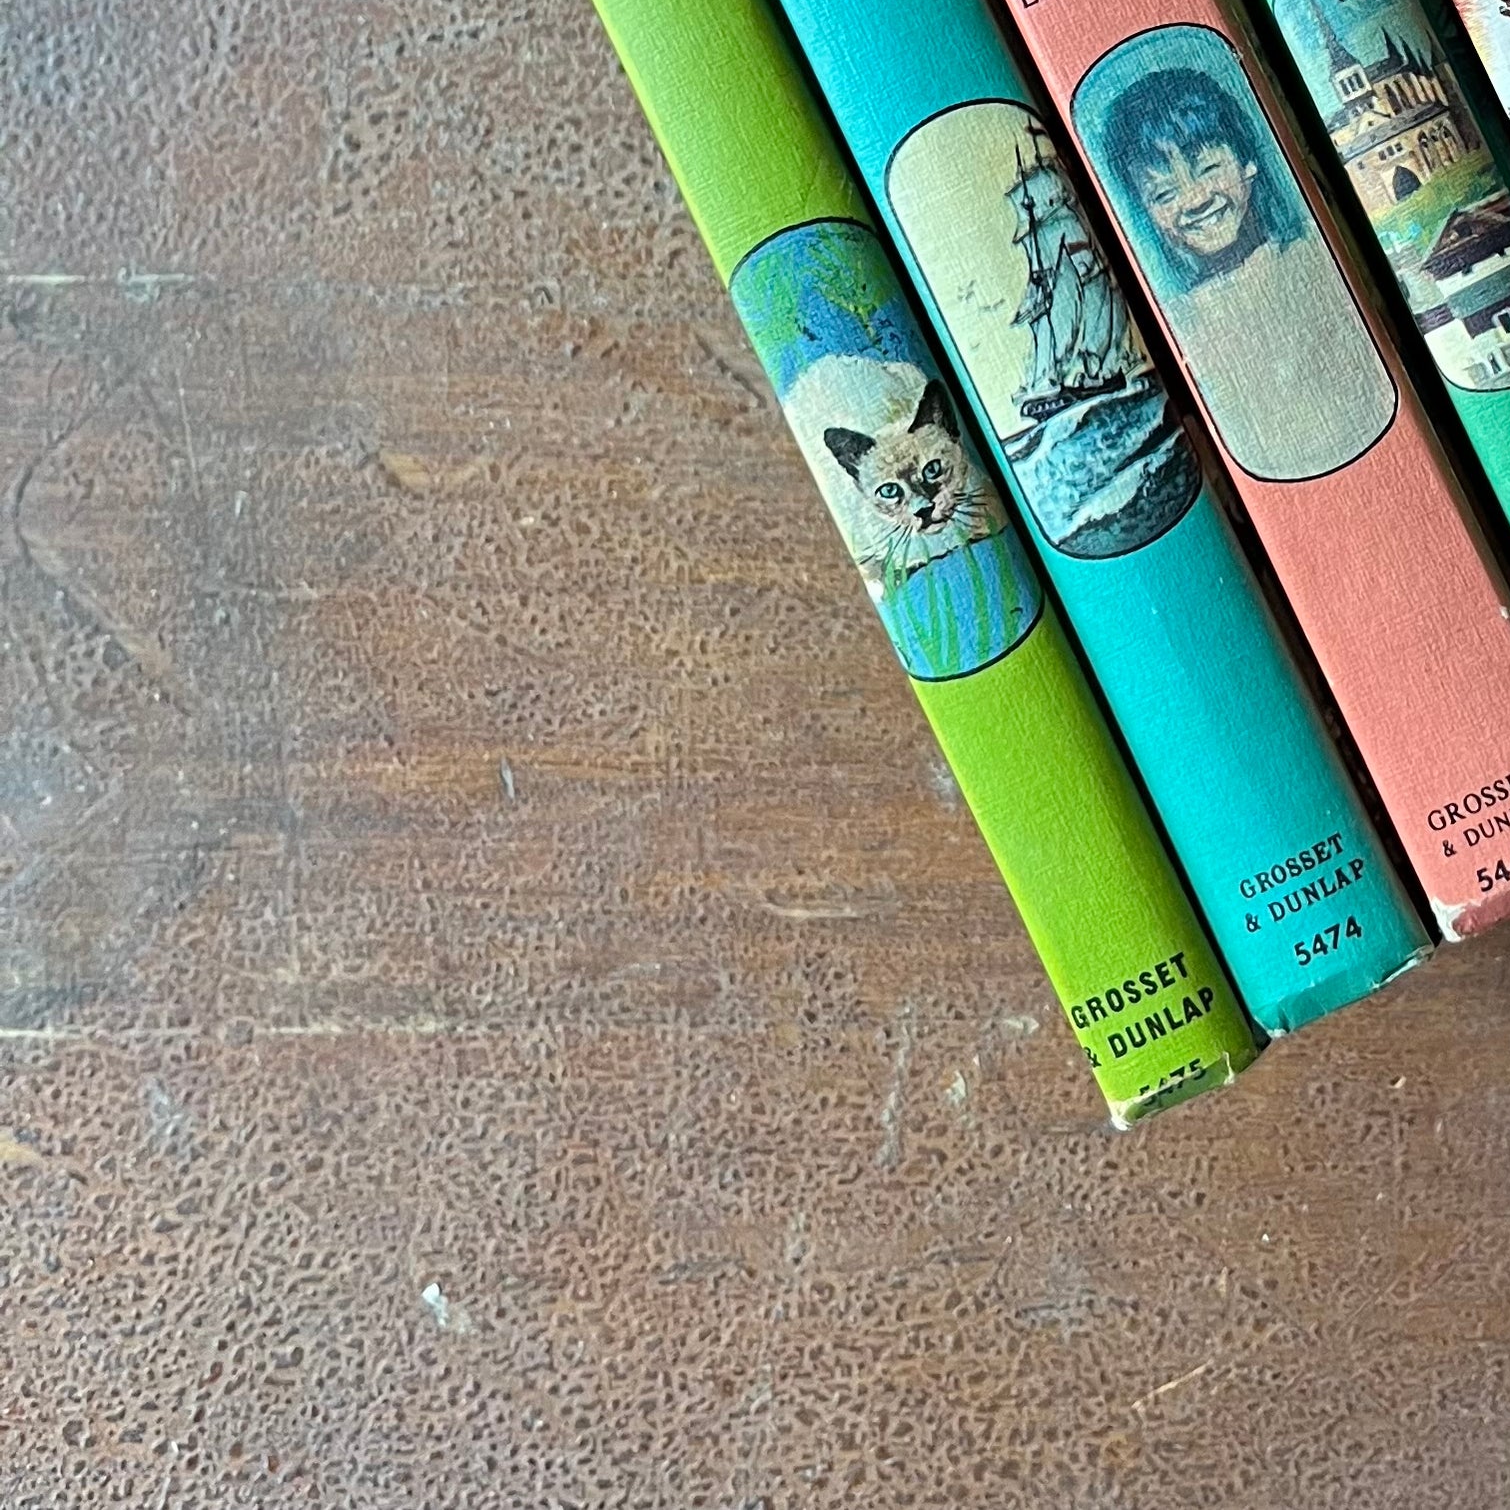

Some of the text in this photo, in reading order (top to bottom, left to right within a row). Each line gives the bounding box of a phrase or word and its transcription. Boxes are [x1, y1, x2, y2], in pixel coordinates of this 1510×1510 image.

[1239, 832, 1344, 899] GROSSET
[1442, 839, 1457, 858] &
[1244, 858, 1365, 933] & DUNLAP
[1294, 915, 1362, 966] 5474
[1071, 951, 1188, 1029] GROSSET
[1107, 986, 1214, 1058] DUNLAP
